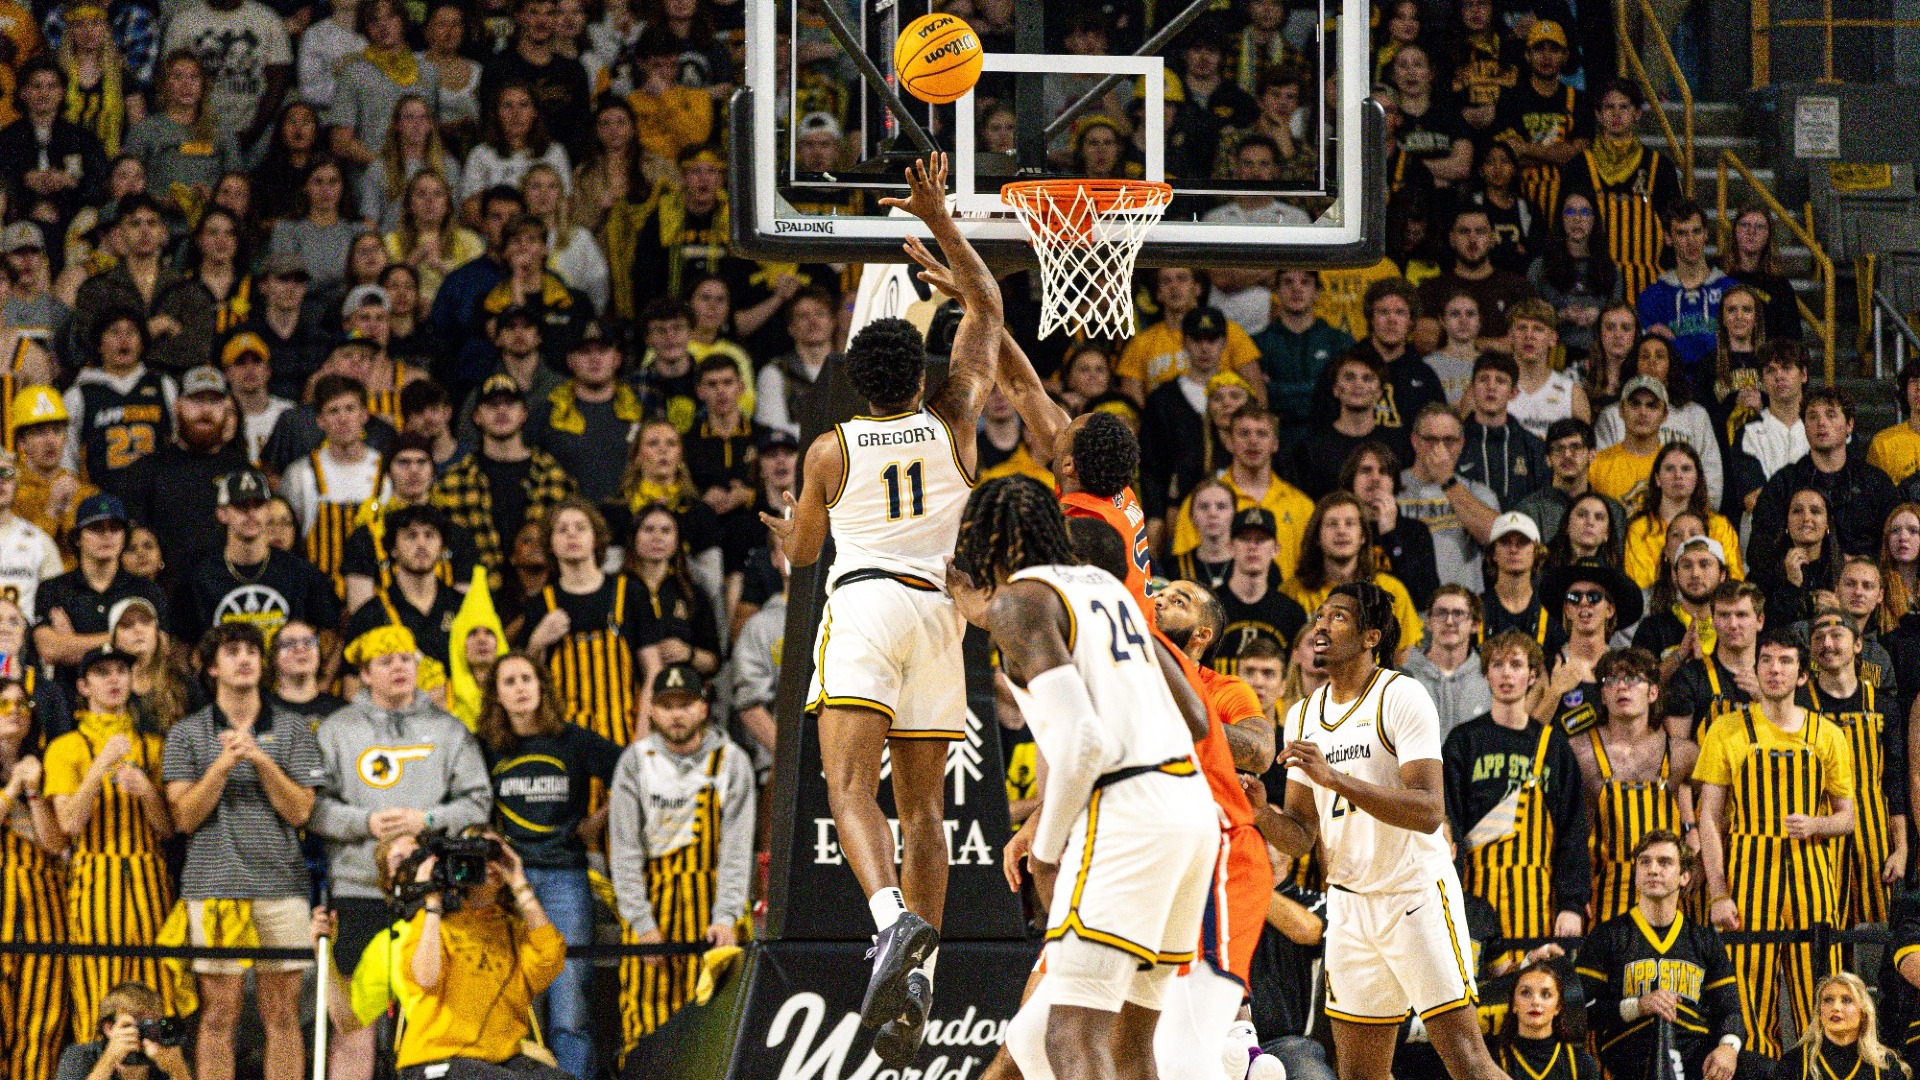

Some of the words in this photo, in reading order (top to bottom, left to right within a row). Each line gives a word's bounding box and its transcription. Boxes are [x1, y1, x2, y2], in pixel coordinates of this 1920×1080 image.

[918, 17, 955, 39] NCAA
[924, 33, 977, 64] Wilson
[775, 220, 834, 234] SPALDING
[106, 424, 155, 467] 23
[857, 426, 937, 447] GREGORY
[880, 458, 926, 522] 11
[1089, 600, 1151, 666] 24
[1326, 744, 1371, 765] ntaineers
[1472, 753, 1505, 783] APP
[500, 776, 570, 797] APPALACHIAN
[1624, 958, 1657, 998] APP
[1658, 958, 1705, 1005] STATE
